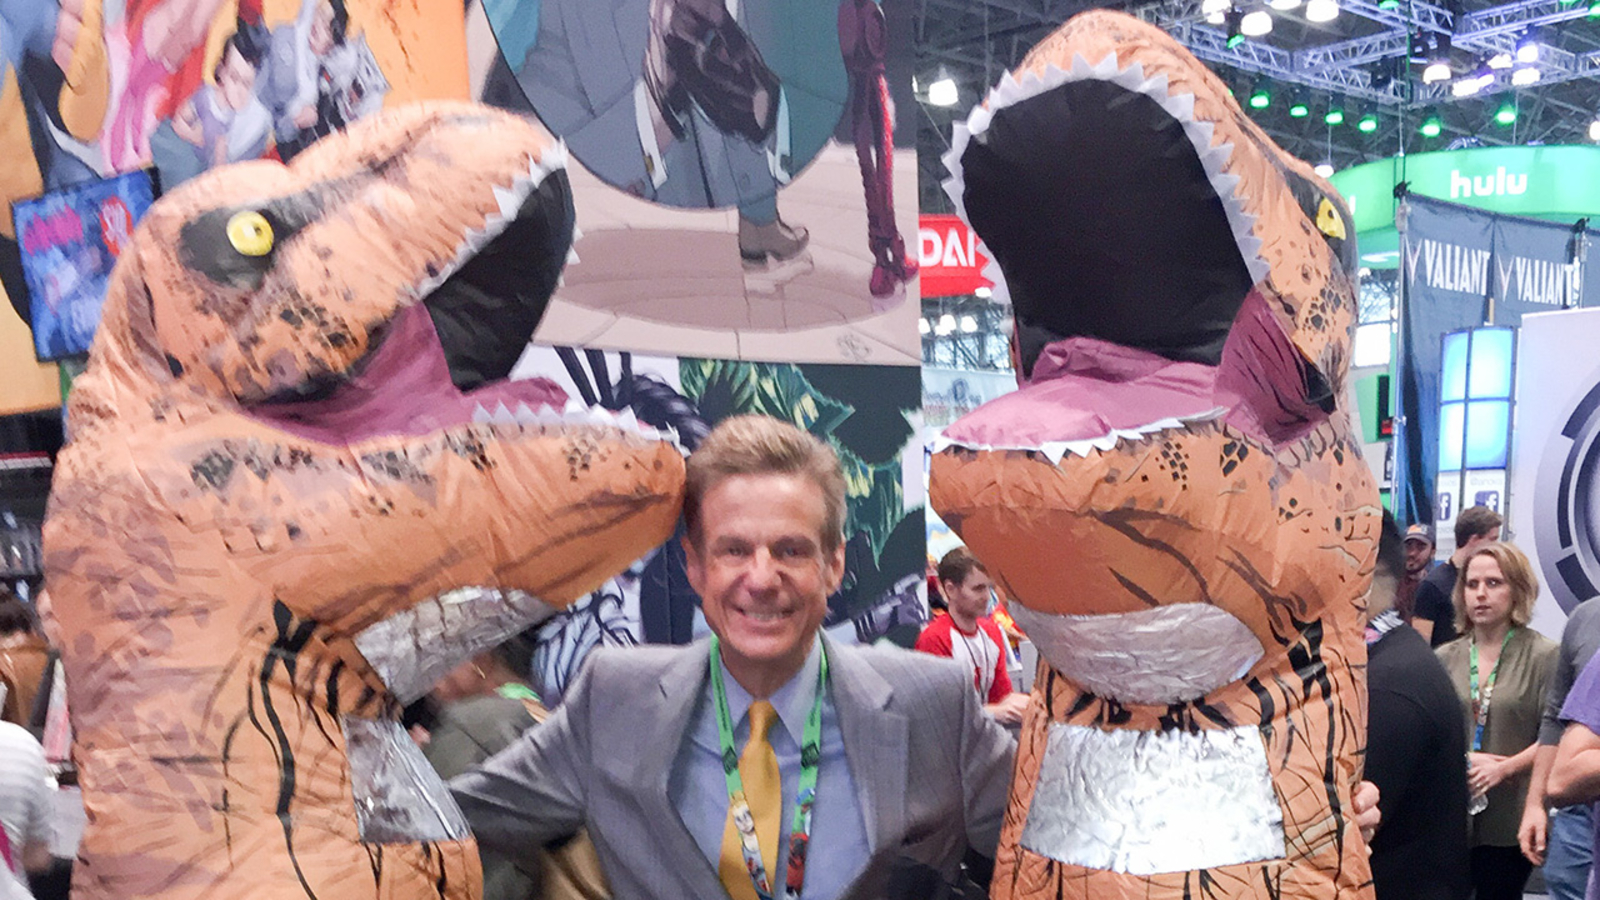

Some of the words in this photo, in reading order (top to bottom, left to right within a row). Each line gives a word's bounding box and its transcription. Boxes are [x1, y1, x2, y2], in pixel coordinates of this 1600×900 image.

[1451, 167, 1527, 198] hulu
[919, 229, 976, 267] DAI
[1424, 240, 1490, 296] VALIANT
[1515, 256, 1574, 306] VALIANT
